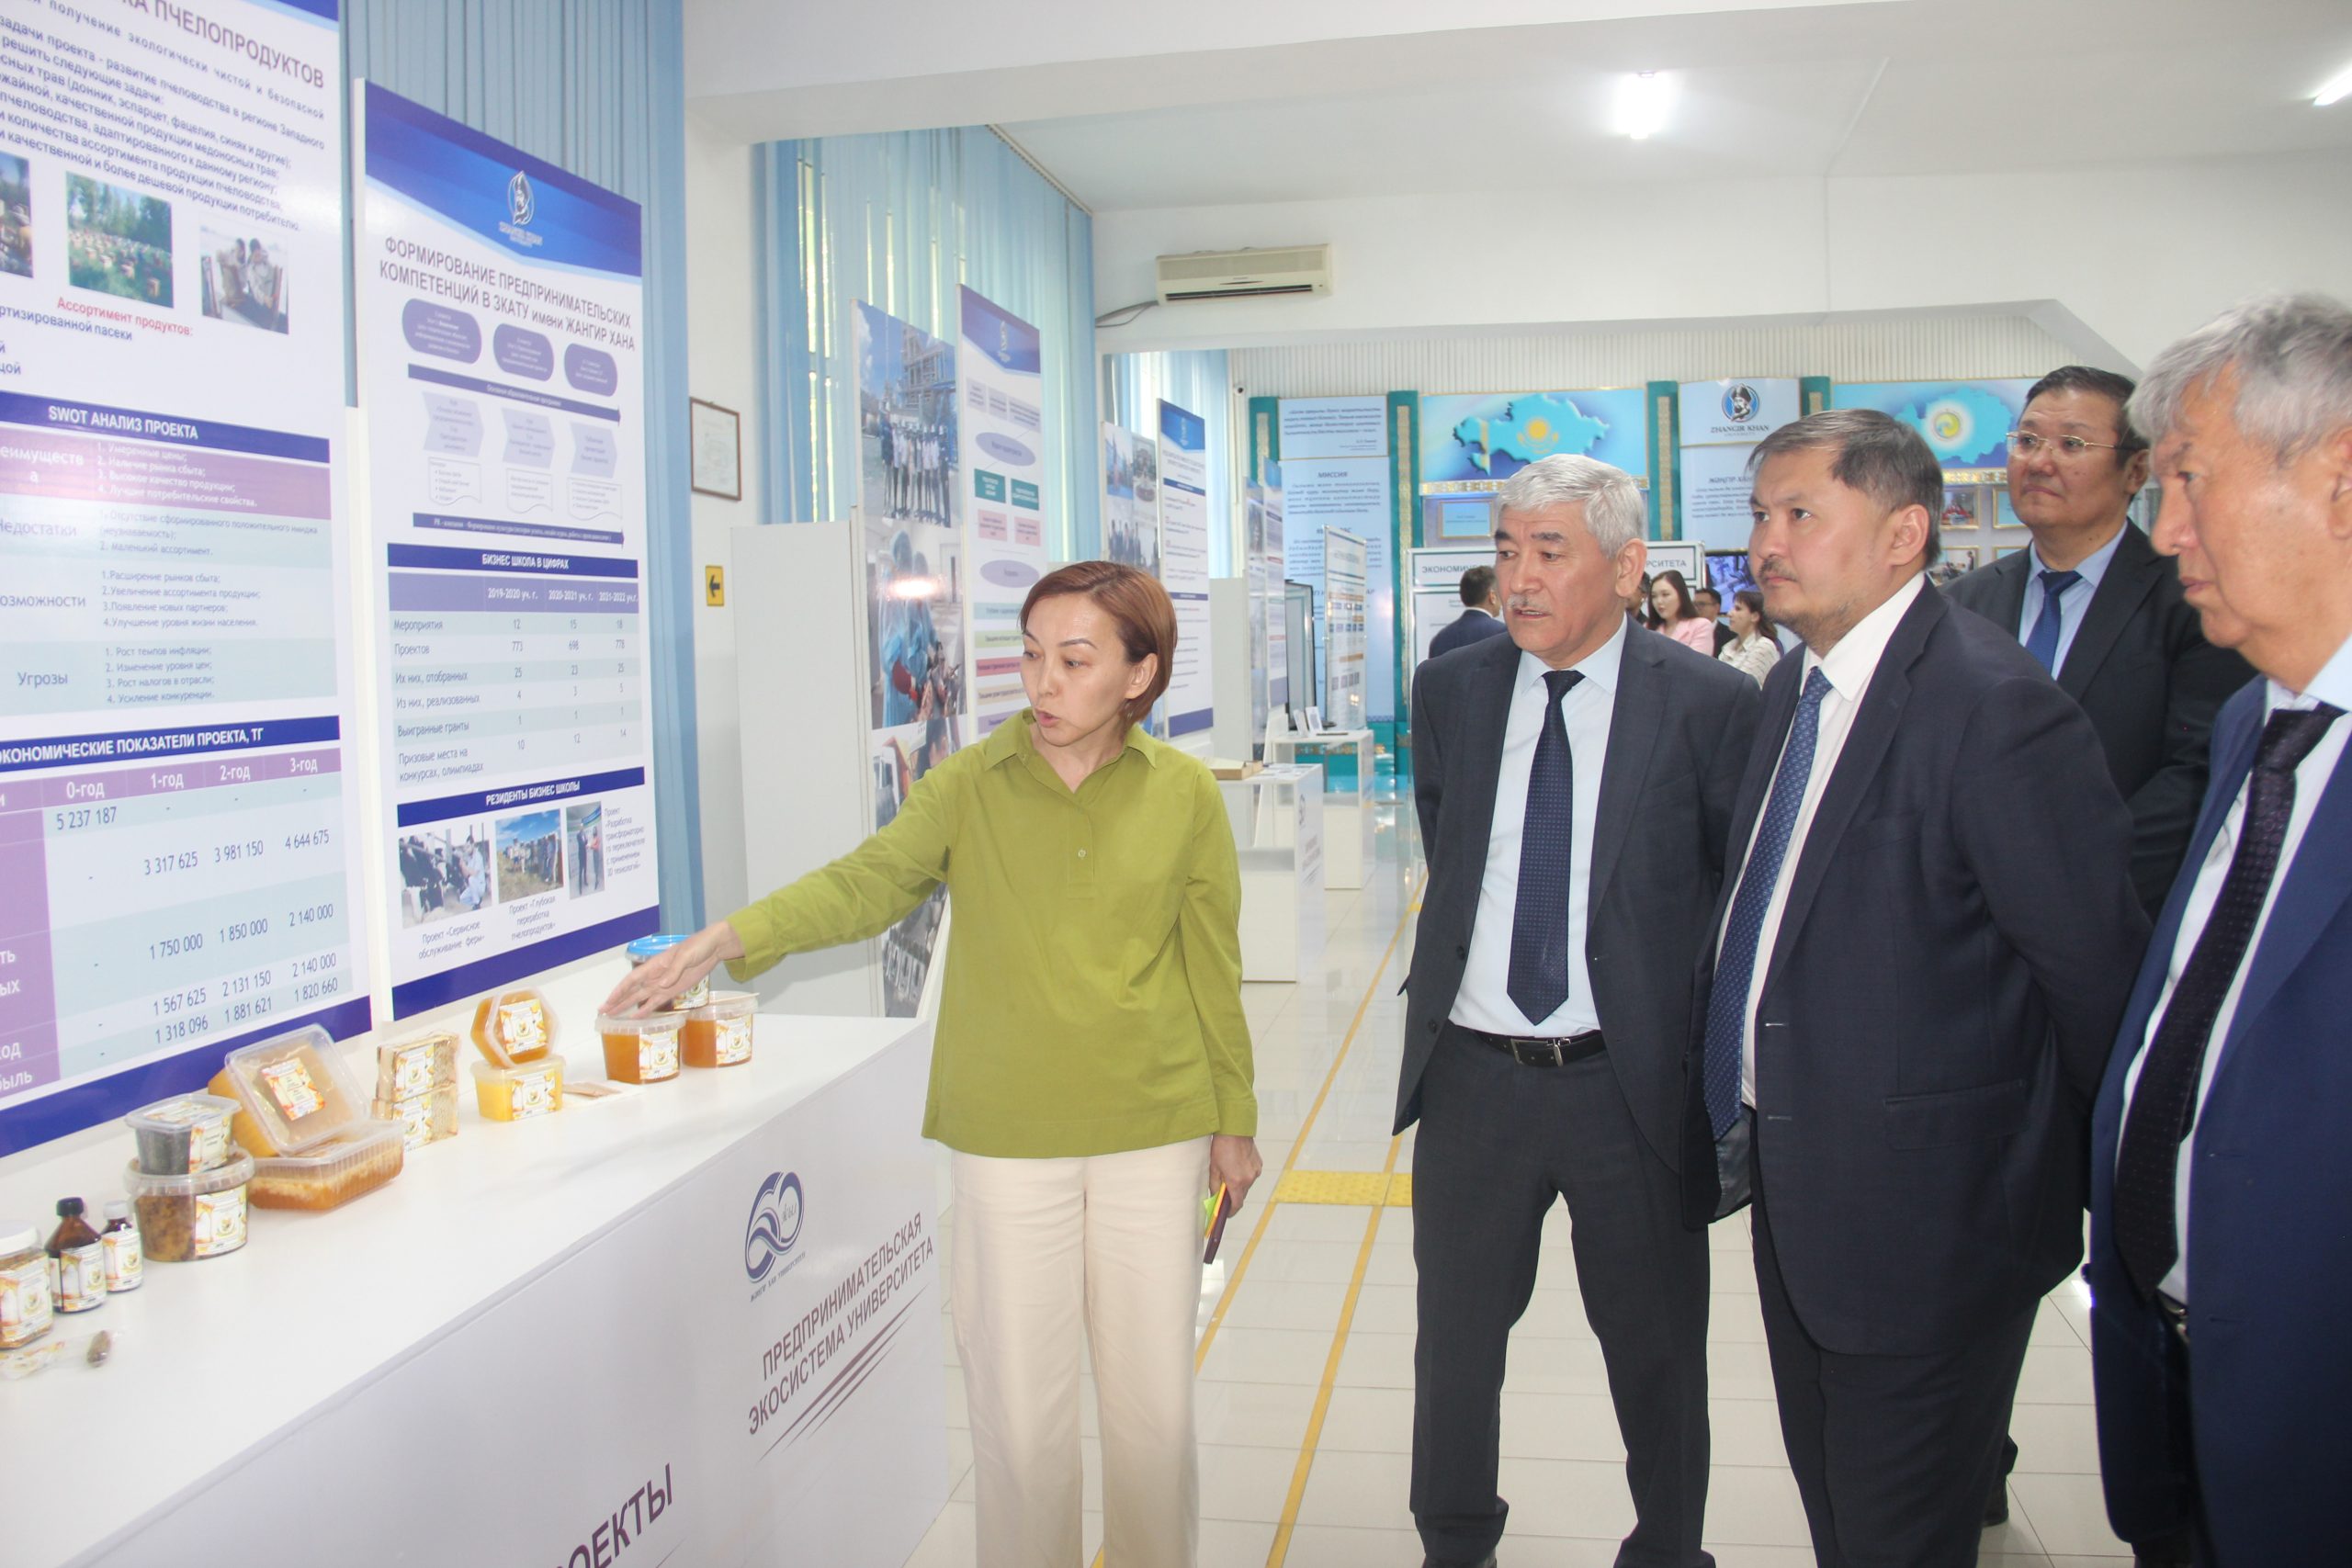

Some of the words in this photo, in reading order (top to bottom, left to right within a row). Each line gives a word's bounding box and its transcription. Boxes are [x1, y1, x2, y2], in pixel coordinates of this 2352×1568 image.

[48, 0, 119, 36] получение
[128, 32, 207, 72] экологически
[213, 68, 250, 89] чистой
[256, 85, 262, 95] и
[267, 87, 323, 118] безопасной
[153, 0, 323, 88] ПЧЕЛОПРОДУКТОВ
[0, 12, 42, 39] задачи
[46, 35, 95, 62] проекта
[106, 58, 156, 85] развитие
[159, 79, 230, 113] пчеловодства
[232, 107, 238, 117] в
[241, 110, 277, 131] регионе
[280, 123, 324, 150] Западного
[1, 35, 50, 62] решить
[52, 55, 121, 89] следующие
[124, 82, 161, 104] задачи:
[37, 67, 65, 85] трав
[67, 76, 116, 105] (донник,
[119, 97, 167, 122] эспарцет,
[0, 89, 88, 130] пчеловодства,
[93, 123, 187, 163] адаптированного
[195, 158, 236, 182] данному
[55, 92, 134, 128] качественной
[136, 121, 192, 148] продукции
[194, 141, 254, 169] медоносных
[6, 112, 78, 144] количества
[80, 137, 158, 170] ассортимента
[160, 163, 213, 187] продукции
[6, 131, 92, 165] качественной
[103, 160, 136, 180] более
[137, 173, 184, 195] дешевой
[186, 187, 238, 211] продукции
[385, 237, 495, 286] ФОРМИРОВАНИЕ
[499, 272, 630, 328] ПРЕДПРИНИМАТЕЛЬСКИХ
[56, 296, 131, 322] Ассортимент
[134, 315, 190, 336] продуктов:
[379, 260, 478, 304] КОМПЕТЕНЦИЙ
[481, 290, 490, 308] В
[493, 294, 528, 319] ЗКАТУ
[531, 310, 562, 329] имени
[566, 317, 606, 341] ЖАНГИР
[609, 331, 634, 350] ХАНА
[94, 324, 131, 340] пасеки
[48, 405, 87, 423] SWOT
[90, 412, 141, 432] АНАЛИЗ
[144, 418, 198, 439] ПРОЕКТА
[481, 553, 510, 566] БИЗНЕС
[511, 556, 536, 567] ШКОЛА
[536, 557, 542, 568] В
[542, 558, 569, 569] ЦИФРАХ
[487, 587, 520, 599] 2019-2020
[393, 619, 443, 632] Мероприятия
[513, 618, 520, 629] 12
[115, 646, 134, 656] Рост
[394, 642, 429, 657] Проектов
[17, 671, 68, 688] Угрозы
[117, 677, 136, 687] Рост
[395, 673, 405, 682] Их
[407, 674, 424, 683] них,
[425, 670, 467, 683] отобранных
[514, 666, 522, 678] 25
[396, 697, 406, 708] Из
[408, 699, 424, 708] них,
[426, 694, 480, 708] реализованных
[516, 690, 521, 698] 4
[0, 739, 114, 763] КОНОМИЧЕСКИЕ
[116, 733, 195, 753] ПОКАЗАТЕЛИ
[197, 728, 250, 747] ПРОЕКТА,
[250, 727, 263, 740] ТГ
[397, 724, 443, 738] Выигранные
[444, 722, 469, 734] гранты
[398, 751, 435, 766] Призовые
[436, 749, 458, 760] места
[458, 748, 468, 757] на
[517, 739, 525, 750] 10
[65, 781, 105, 799] 0-год
[150, 773, 184, 789] 1-год
[220, 764, 250, 781] 2-год
[289, 757, 317, 773] 3-год
[399, 769, 440, 783] конкурсах,
[441, 762, 482, 776] олимпиадах
[485, 788, 527, 806] РЕЗИДЕНТЫ
[528, 784, 554, 798] БИЗНЕС
[555, 780, 580, 794] ШКОЛЫ
[56, 812, 64, 830] 5
[68, 809, 90, 829] 237
[96, 806, 117, 824] 187
[144, 859, 150, 875] 3
[154, 854, 172, 874] 317
[177, 851, 198, 869] 625
[214, 846, 220, 863] 3
[223, 844, 241, 860] 981
[245, 840, 263, 856] 150
[284, 835, 291, 852] 4
[293, 833, 310, 848] 644
[312, 829, 329, 845] 675
[509, 902, 527, 915] Проект
[516, 910, 549, 926] переработка
[149, 942, 155, 961] 1
[159, 938, 180, 957] 750
[182, 932, 202, 952] 000
[220, 929, 224, 942] 1
[228, 922, 247, 941] 850
[249, 918, 267, 936] 000
[288, 911, 295, 927] 2
[298, 908, 314, 923] 140
[316, 903, 334, 919] 000
[418, 940, 462, 959] обслуживание
[422, 931, 444, 944] Проект
[153, 1000, 158, 1015] 1
[163, 993, 183, 1013] 567
[187, 987, 206, 1007] 625
[222, 981, 229, 997] 2
[232, 976, 248, 993] 131
[254, 969, 271, 987] 150
[292, 962, 298, 977] 2
[301, 957, 317, 974] 140
[319, 952, 335, 969] 000
[155, 1029, 160, 1043] 1
[165, 1021, 185, 1041] 318
[188, 1015, 208, 1033] 096
[224, 1009, 229, 1022] 1
[233, 1002, 250, 1021] 881
[254, 996, 271, 1014] 621
[294, 988, 299, 1001] 1
[302, 982, 319, 999] 820
[321, 976, 337, 994] 660
[763, 1212, 922, 1382] ПРЕДПРИНИМАТЕЛЬСКАЯ
[749, 1323, 845, 1436] ЭКОСИСТЕМА
[849, 1235, 933, 1337] УНИВЕРСИТЕТА
